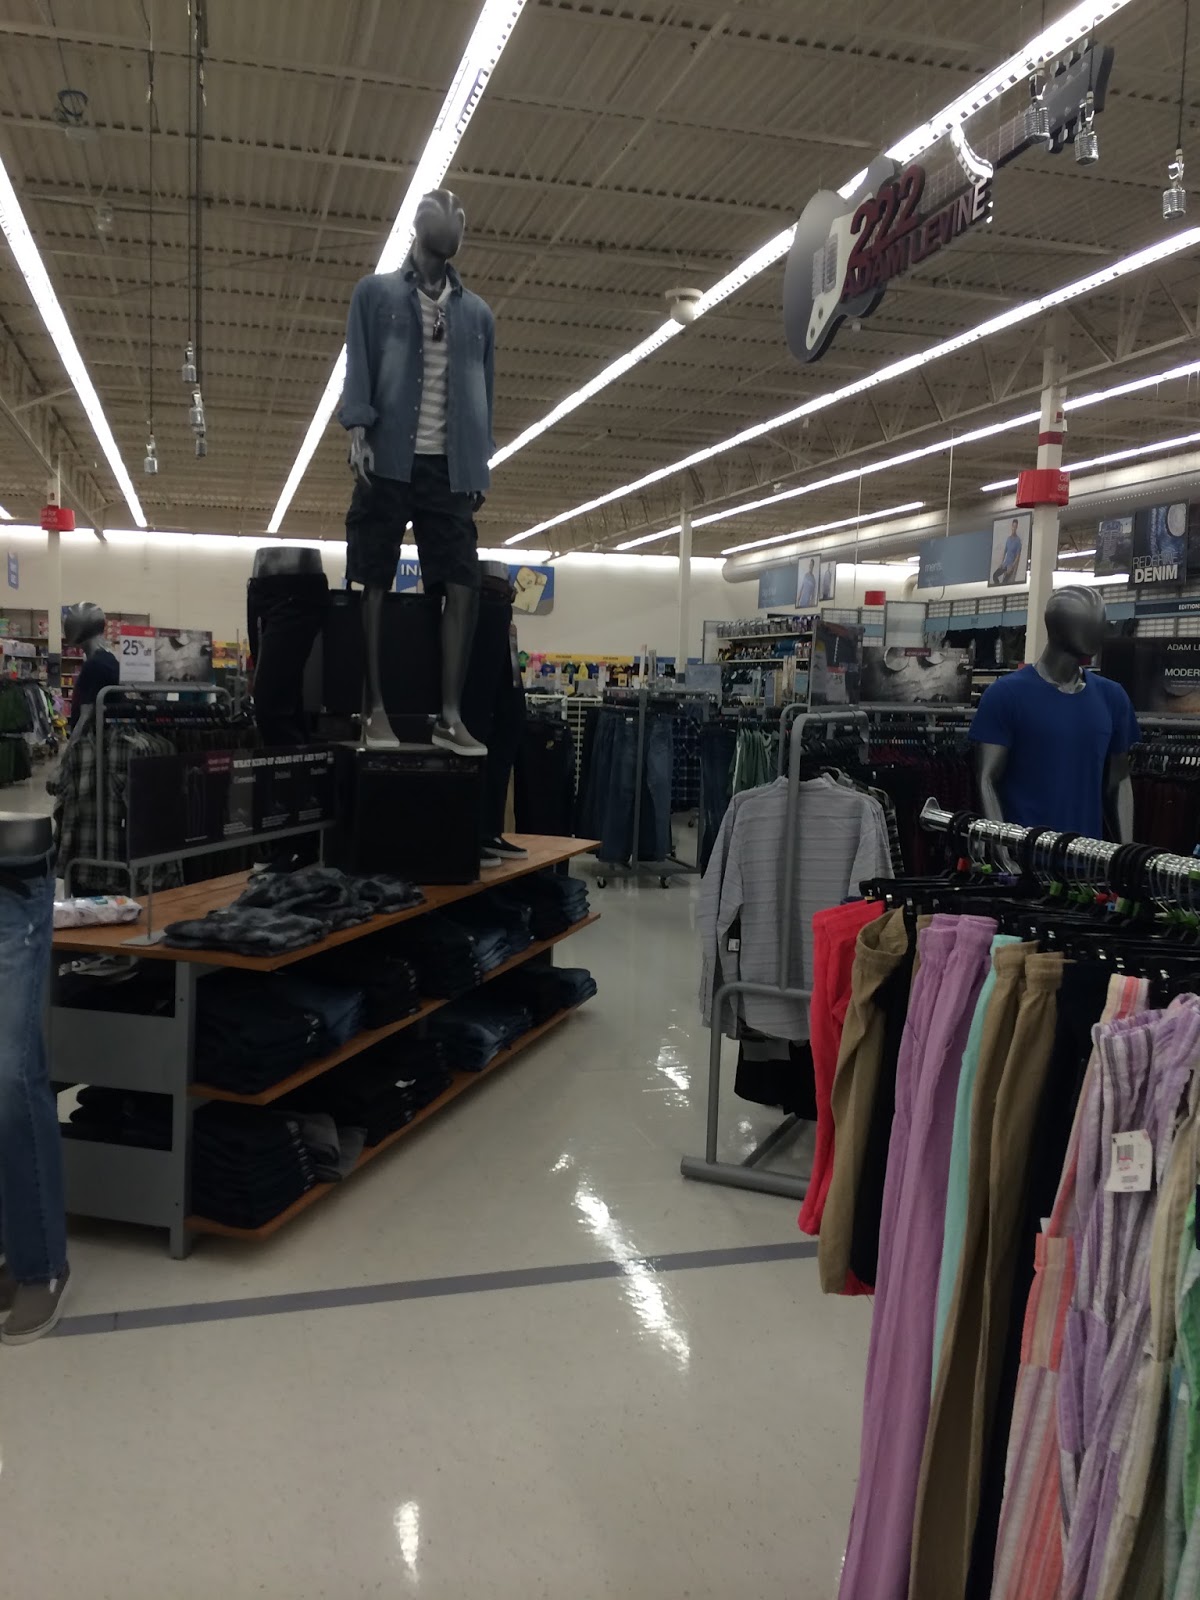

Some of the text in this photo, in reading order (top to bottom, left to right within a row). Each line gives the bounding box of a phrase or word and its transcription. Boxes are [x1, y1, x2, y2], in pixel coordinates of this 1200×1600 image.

[850, 164, 925, 257] 222
[909, 180, 990, 264] LEVINE
[1134, 564, 1179, 584] DENIM
[1166, 643, 1192, 652] ADAM
